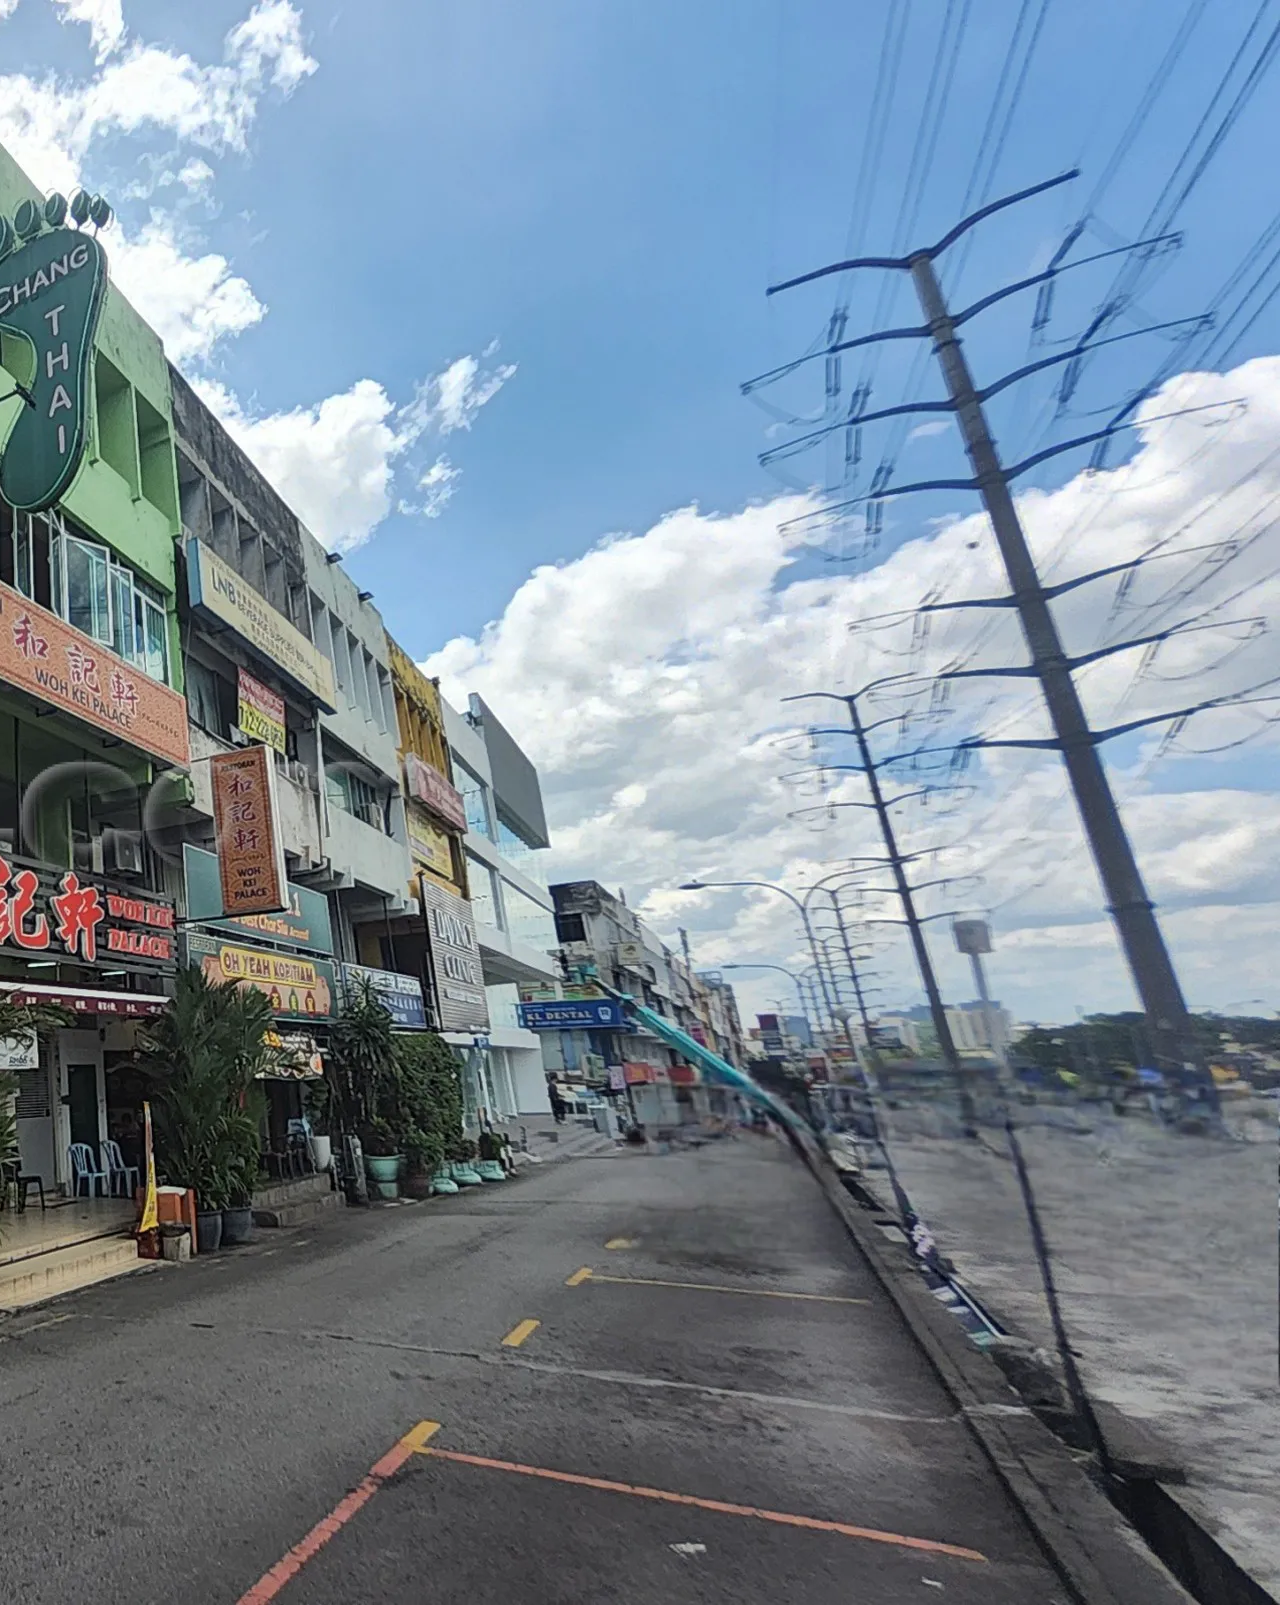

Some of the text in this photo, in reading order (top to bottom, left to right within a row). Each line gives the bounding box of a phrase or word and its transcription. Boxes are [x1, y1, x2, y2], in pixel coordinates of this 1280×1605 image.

[44, 305, 72, 454] THAI
[13, 613, 140, 717] 和記軒
[34, 667, 69, 699] WOH
[70, 687, 91, 708] KEI
[92, 695, 133, 730] PALACE
[228, 774, 260, 851] 和記軒
[237, 866, 261, 877] WOH
[106, 894, 145, 923] WOH
[234, 887, 268, 900] PALACE
[107, 928, 170, 960] PALACE
[223, 952, 240, 974] OH
[242, 955, 270, 977] YEAH
[545, 1010, 593, 1021] DENTAL
